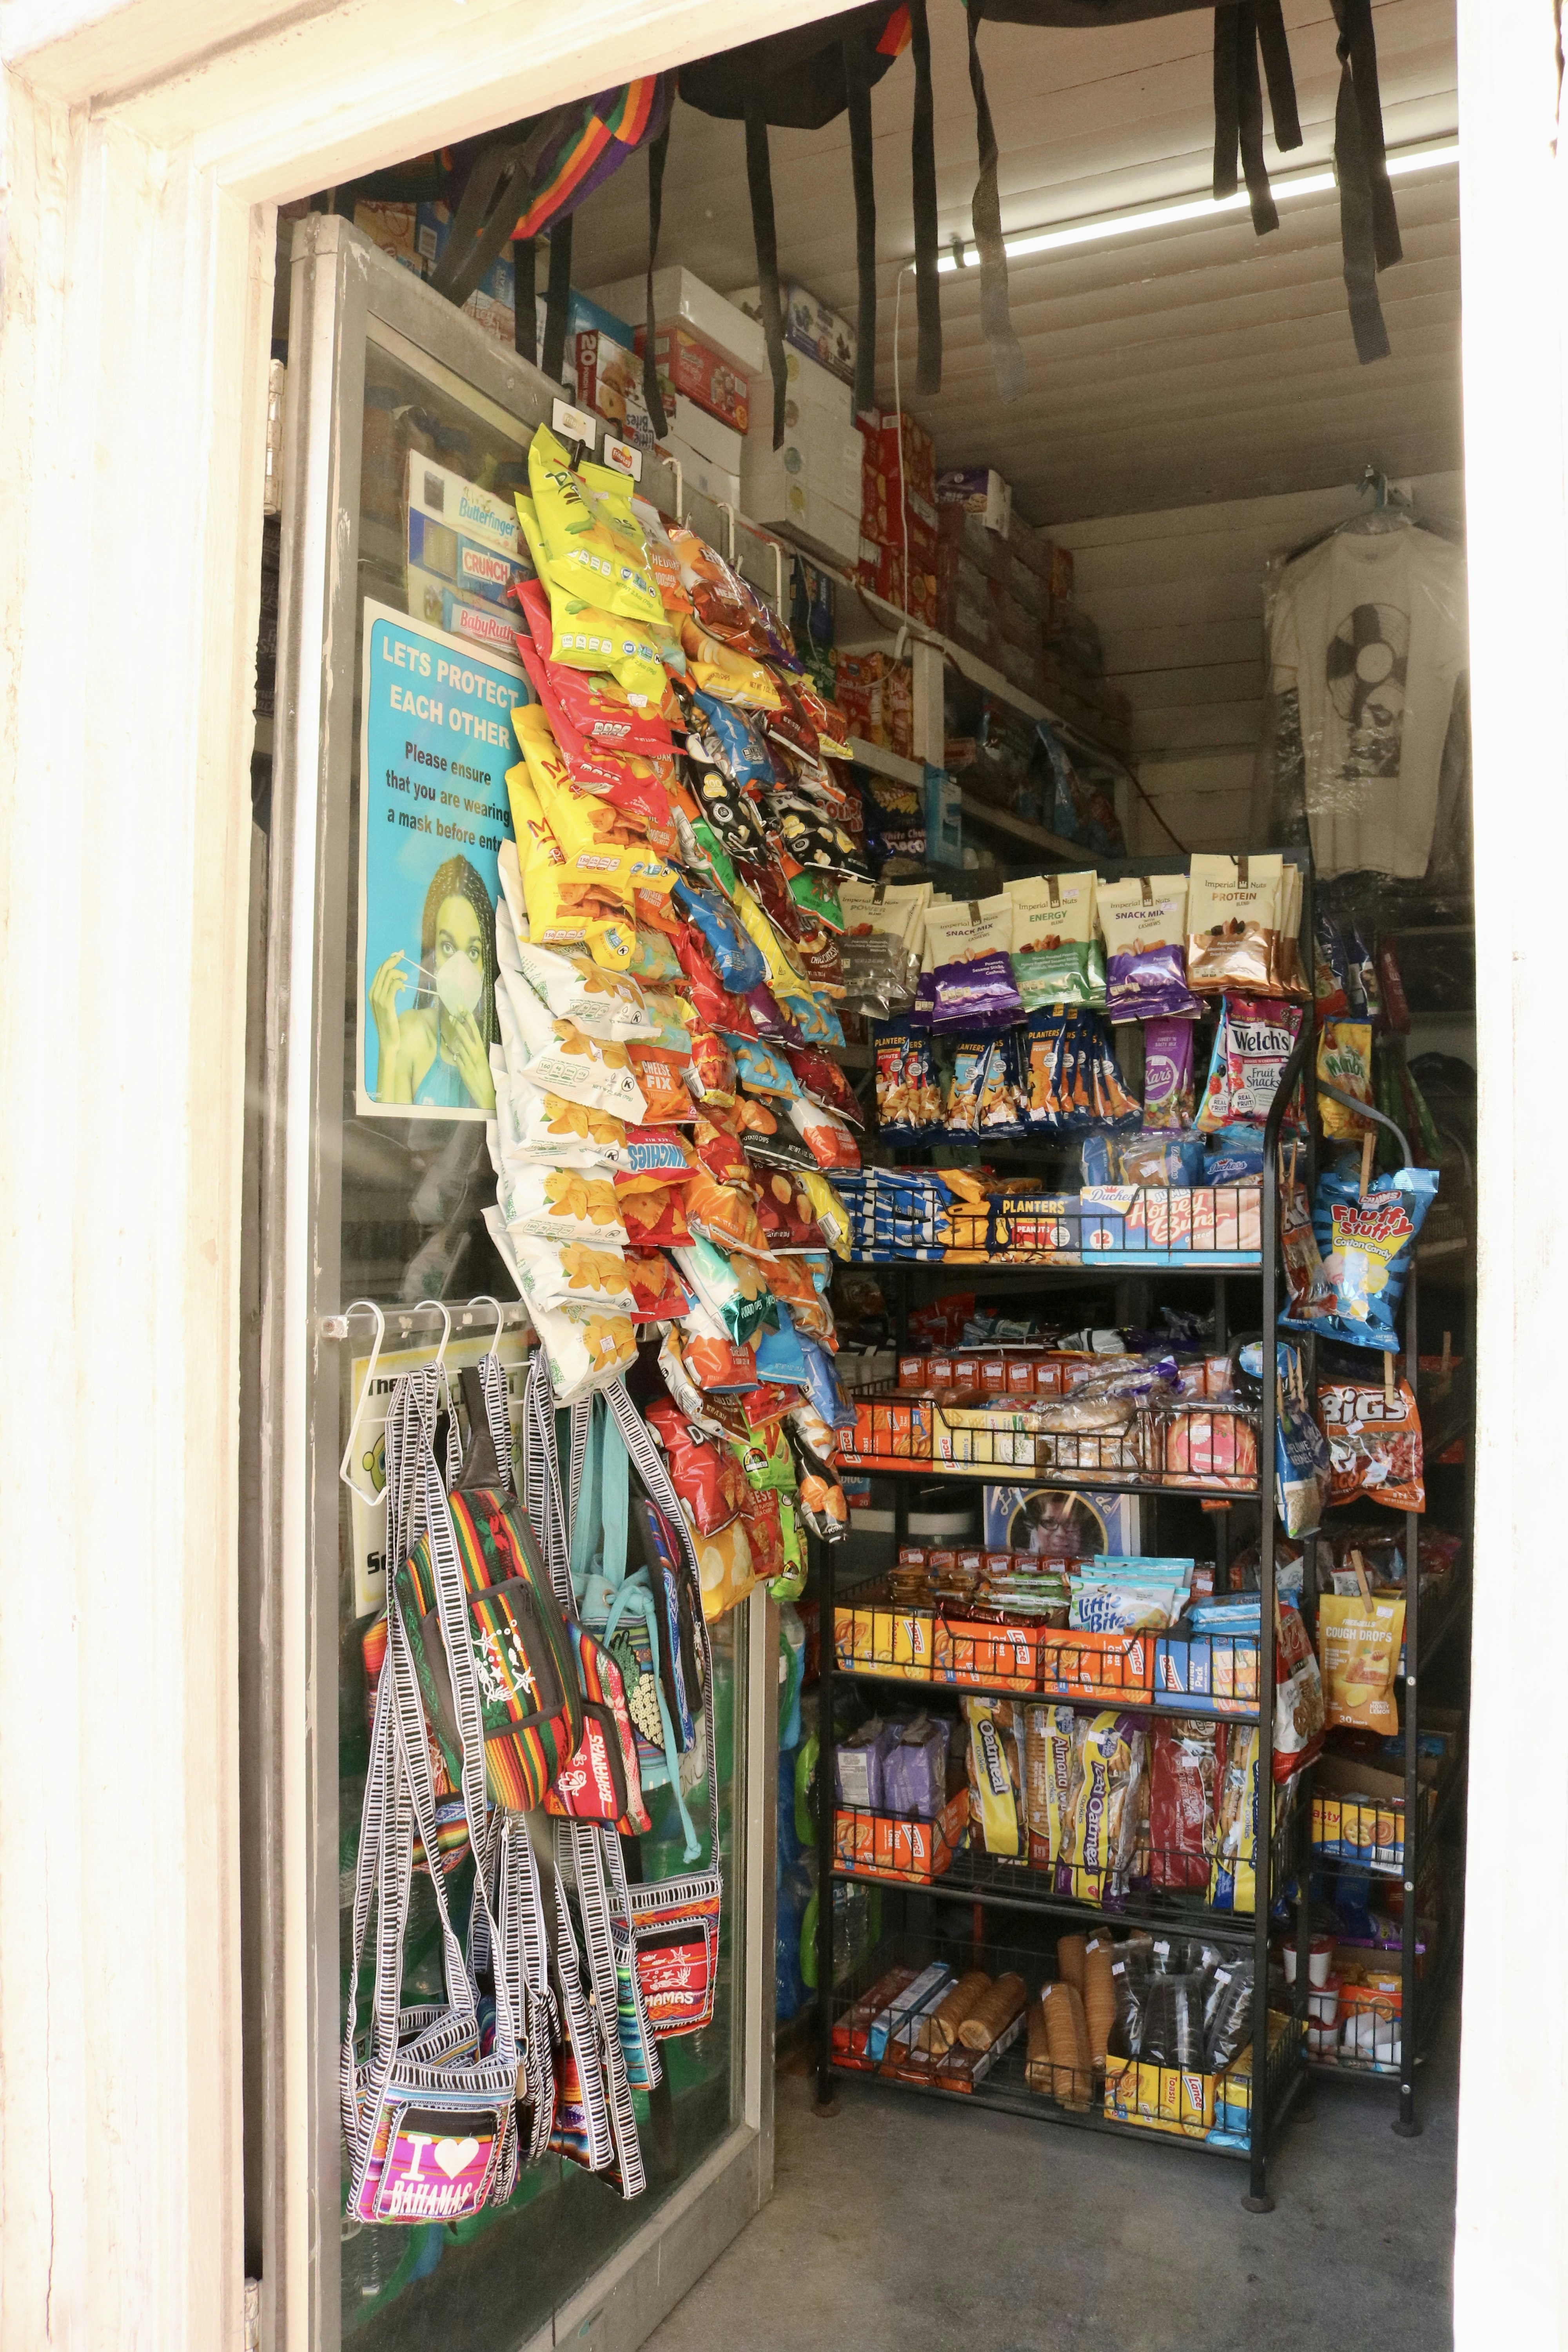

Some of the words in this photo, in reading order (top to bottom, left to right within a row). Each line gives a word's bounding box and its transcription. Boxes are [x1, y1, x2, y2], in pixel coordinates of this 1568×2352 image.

[459, 497, 515, 536] Butterfinger
[463, 551, 509, 583] CRUNCH
[383, 636, 431, 677] LETS
[437, 659, 519, 709] PROTECT
[634, 659, 647, 670] 2.5oz
[390, 684, 443, 725] EACH
[449, 708, 510, 750] OTHER
[405, 741, 447, 771] Please
[451, 761, 491, 786] ensure
[704, 779, 722, 788] 100
[386, 769, 410, 793] that
[414, 782, 436, 801] you
[440, 791, 460, 808] are
[464, 798, 510, 828] wearing
[388, 808, 394, 822] a
[399, 811, 432, 834] mask
[437, 818, 475, 845] before
[661, 831, 670, 841] REAL
[1205, 880, 1235, 889] Imperial
[652, 893, 662, 902] REAL
[1212, 892, 1257, 901] PROTEIN
[1019, 902, 1048, 911] Imperial
[1030, 911, 1067, 922] ENERGY
[1115, 911, 1145, 920] SNACK
[977, 923, 993, 932] MIX
[1138, 920, 1161, 929] CASHEWS
[969, 933, 990, 942] CASHEWS
[875, 1037, 906, 1047] PLANTERS
[1029, 1029, 1060, 1039] PLANTERS
[1232, 1029, 1289, 1051] Welch's
[959, 1044, 985, 1052] LANTERS
[642, 1061, 671, 1076] CHEESE
[1252, 1067, 1276, 1078] Fruit
[646, 1075, 672, 1090] FIX
[1145, 1068, 1171, 1086] Kar's
[1247, 1076, 1280, 1088] Snacks
[1207, 1161, 1247, 1175] Duchess
[1089, 1189, 1141, 1201] Duchess
[1003, 1200, 1065, 1214] PLANTERS
[1127, 1193, 1208, 1228] Honey
[1146, 1214, 1221, 1242] Buns
[1331, 1204, 1414, 1236] Fluffy
[1094, 1232, 1110, 1244] 12
[1339, 1221, 1391, 1241] Stuff
[1334, 1236, 1365, 1249] Cotton
[1365, 1242, 1392, 1261] Candy
[1078, 1593, 1121, 1622] Little
[1091, 1612, 1136, 1632] Bites
[1326, 1626, 1356, 1640] COUGH
[1359, 1630, 1392, 1642] DROPS
[1339, 1715, 1352, 1723] 30
[975, 1746, 985, 1773] cookies
[980, 1720, 1009, 1794] Oatmeal
[1053, 1736, 1069, 1789] Almond
[591, 1735, 613, 1803] BAHAMAS
[1078, 1795, 1087, 1824] cookies
[1086, 1798, 1104, 1875] Oatmeal
[645, 1992, 693, 2007] HAMAS
[1168, 2076, 1178, 2105] Toasty
[401, 2134, 432, 2181] I
[390, 2180, 473, 2216] BAHAMAS
